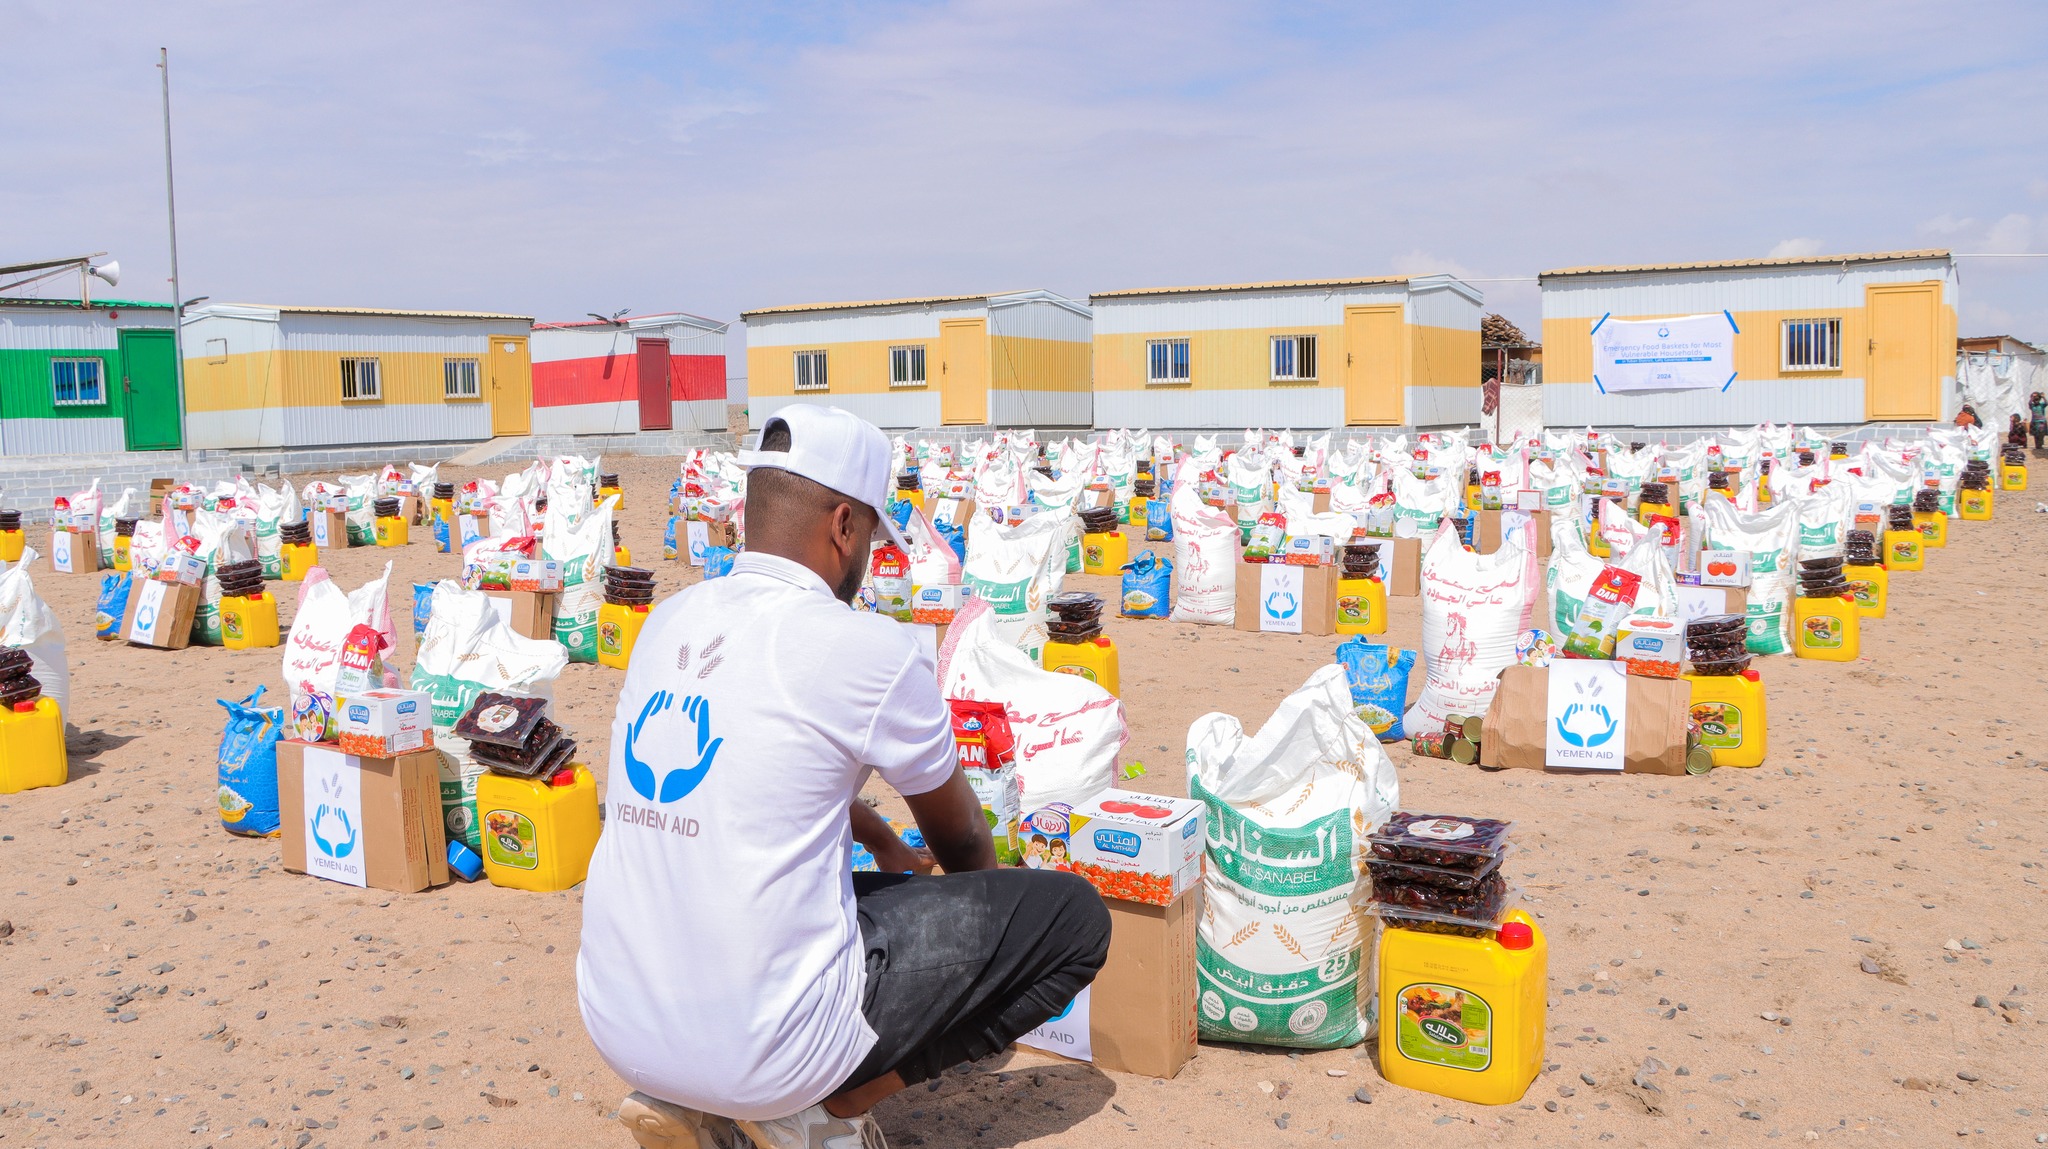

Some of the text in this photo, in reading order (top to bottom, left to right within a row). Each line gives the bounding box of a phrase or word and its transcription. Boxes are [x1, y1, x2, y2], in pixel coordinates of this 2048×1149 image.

[1620, 349, 1703, 358] Vulnerable Households
[879, 566, 900, 575] DANO
[342, 671, 360, 683] Slim
[1556, 749, 1614, 759] YEMEN AID
[617, 802, 700, 838] YEMEN AID
[1107, 815, 1159, 827] MITHALI
[1096, 832, 1137, 846] المثالي
[1206, 806, 1338, 868] السنابل
[313, 856, 358, 875] YEMEN AID
[1258, 901, 1281, 914] أجود
[1301, 891, 1348, 913] مستخلص
[1283, 905, 1299, 915] من
[1324, 954, 1346, 975] 25
[1216, 966, 1309, 994] دقيق أبيض
[1050, 1030, 1075, 1045] AID
